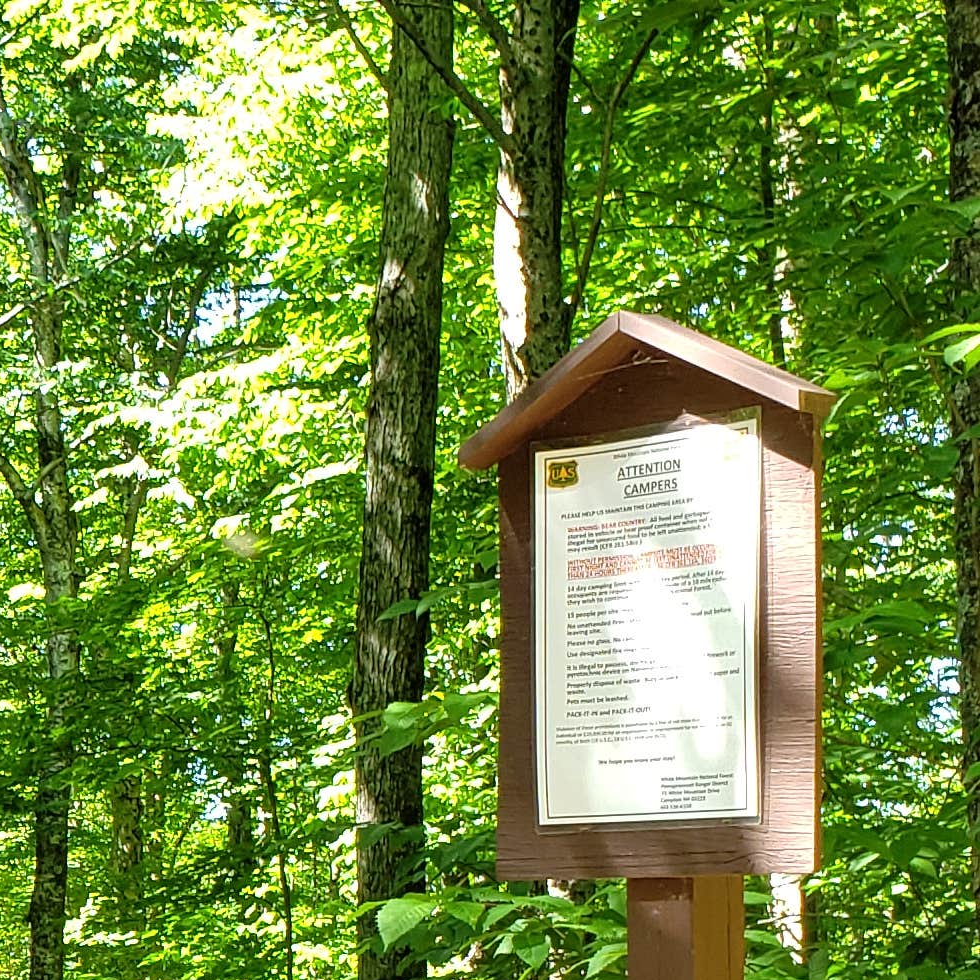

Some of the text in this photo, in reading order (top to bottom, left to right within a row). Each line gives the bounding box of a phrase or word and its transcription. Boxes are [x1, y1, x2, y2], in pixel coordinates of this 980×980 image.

[618, 459, 681, 480] ATTENTION
[624, 478, 678, 497] CAMPERS
[561, 512, 580, 520] PLEASE
